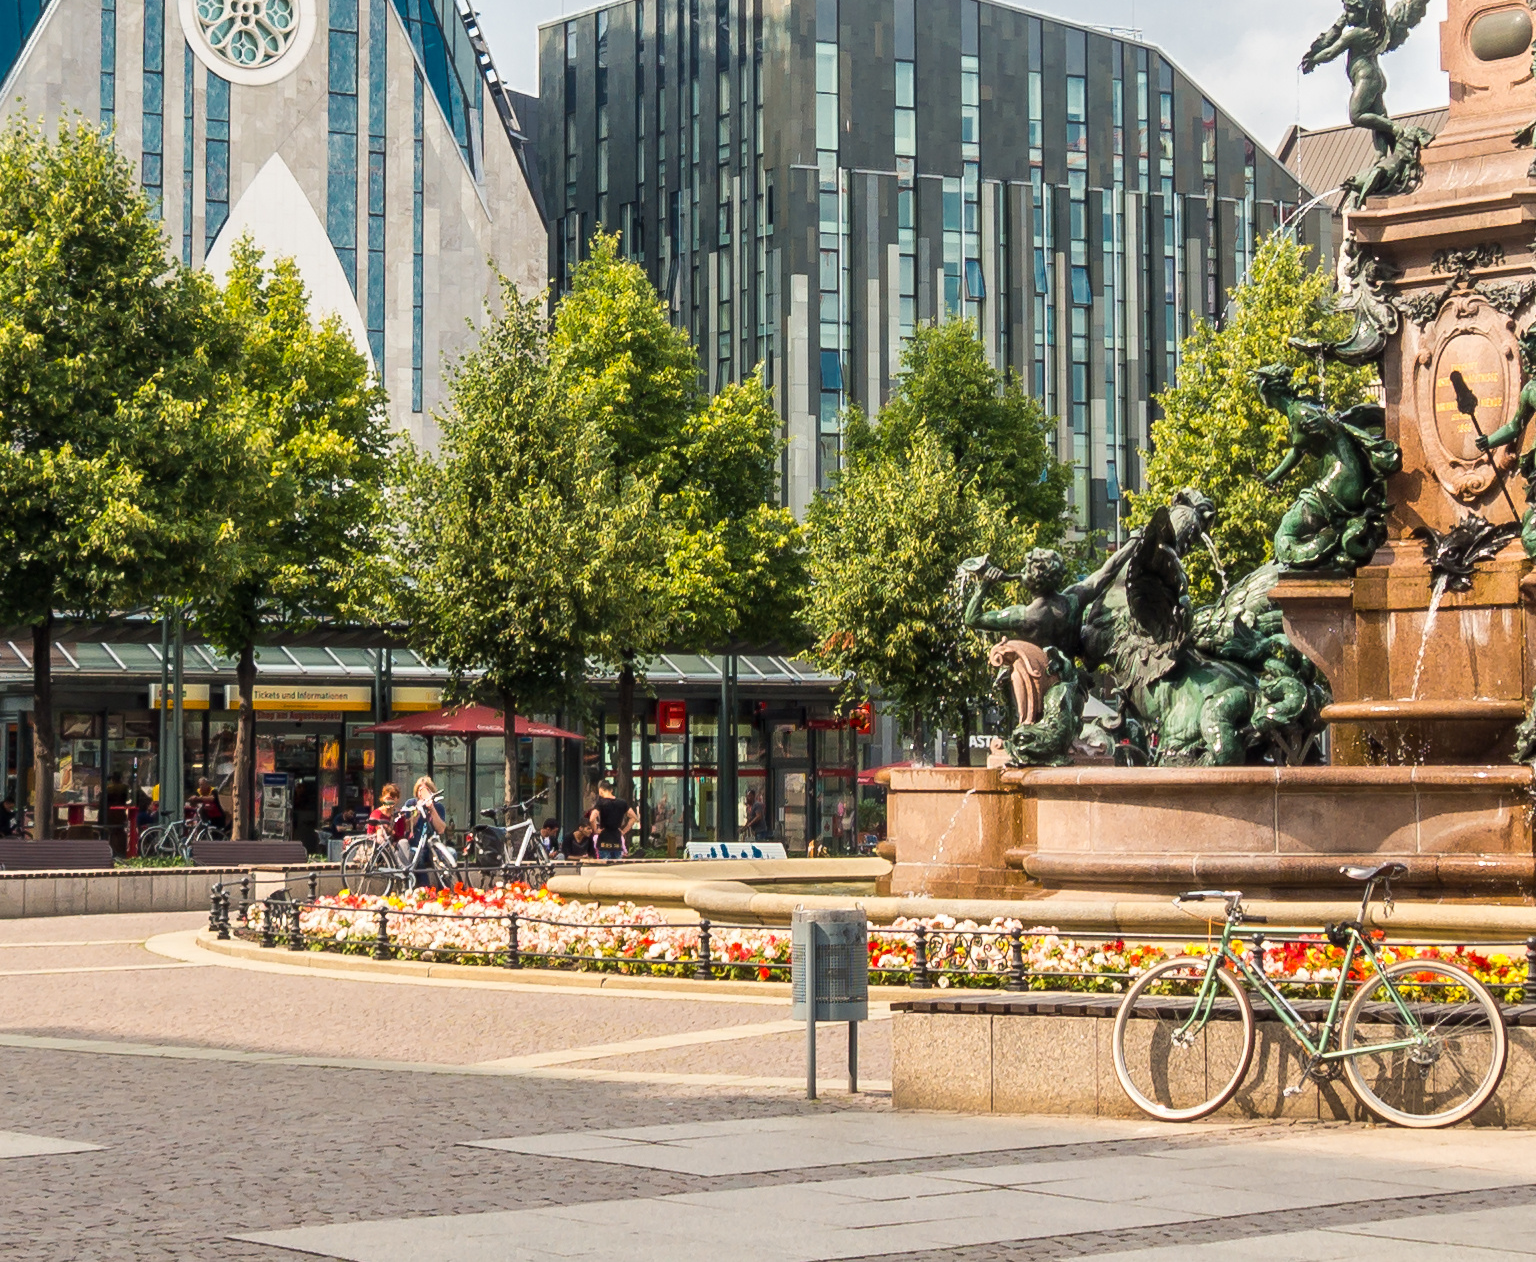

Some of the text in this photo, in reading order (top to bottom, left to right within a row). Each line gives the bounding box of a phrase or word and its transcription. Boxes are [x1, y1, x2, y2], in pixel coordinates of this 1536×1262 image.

[254, 690, 348, 700] Tickets und Informationen
